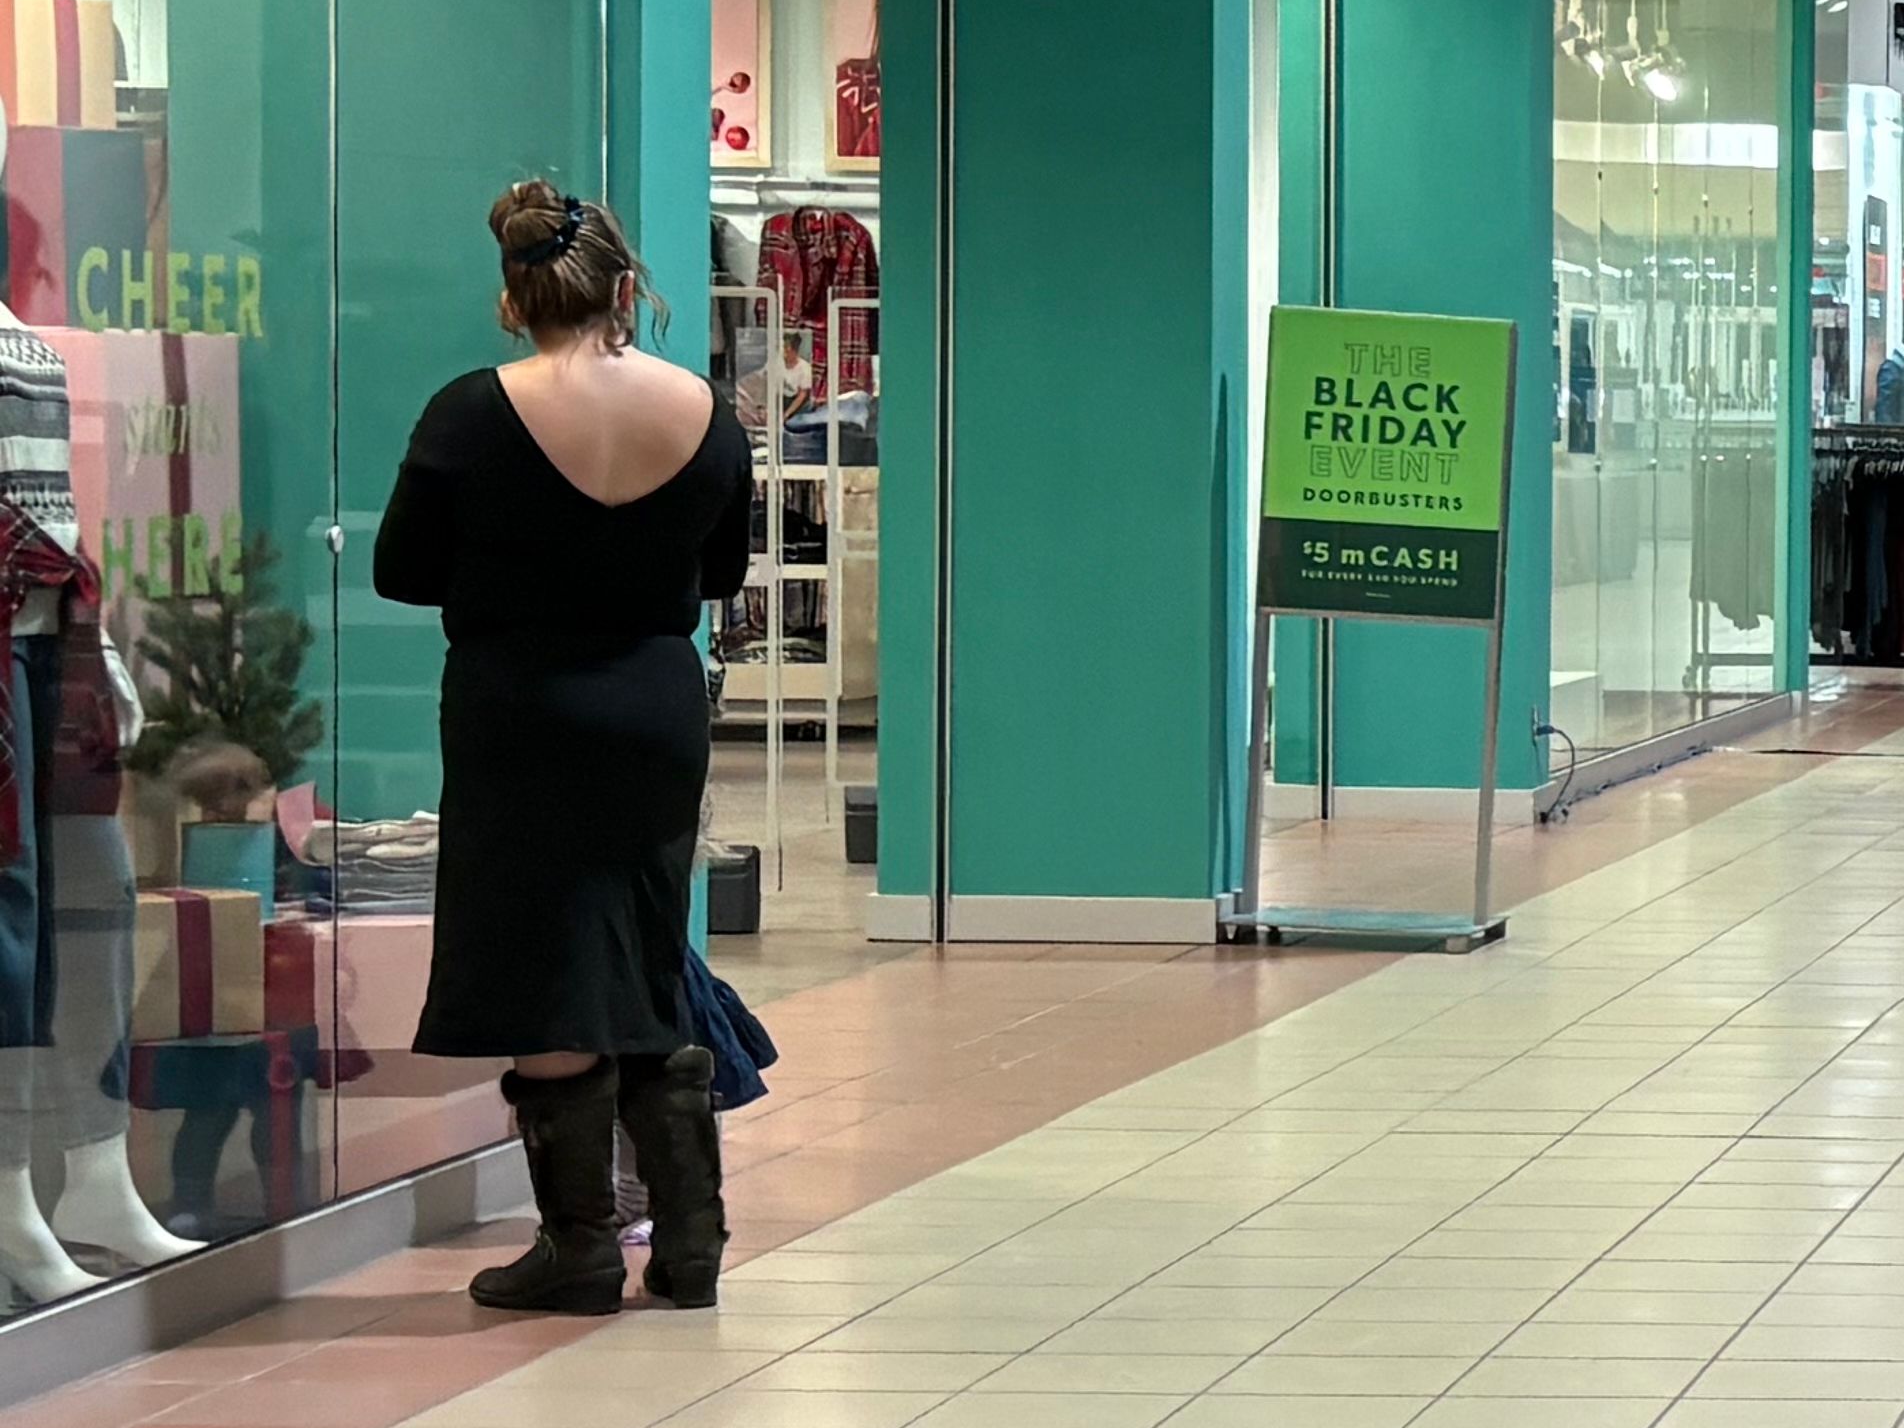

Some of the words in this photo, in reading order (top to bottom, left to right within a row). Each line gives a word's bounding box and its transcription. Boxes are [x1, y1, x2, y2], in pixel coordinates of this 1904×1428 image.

[76, 245, 265, 339] CHEER
[1344, 342, 1432, 379] THE
[1313, 376, 1462, 414] BLACK
[1303, 410, 1467, 449] FRIDAY
[1309, 444, 1460, 486] EVENT
[1302, 486, 1464, 512] DOORBUSTERS
[101, 512, 245, 601] HERE
[1302, 540, 1330, 564] $5
[1341, 545, 1459, 571] mCASH
